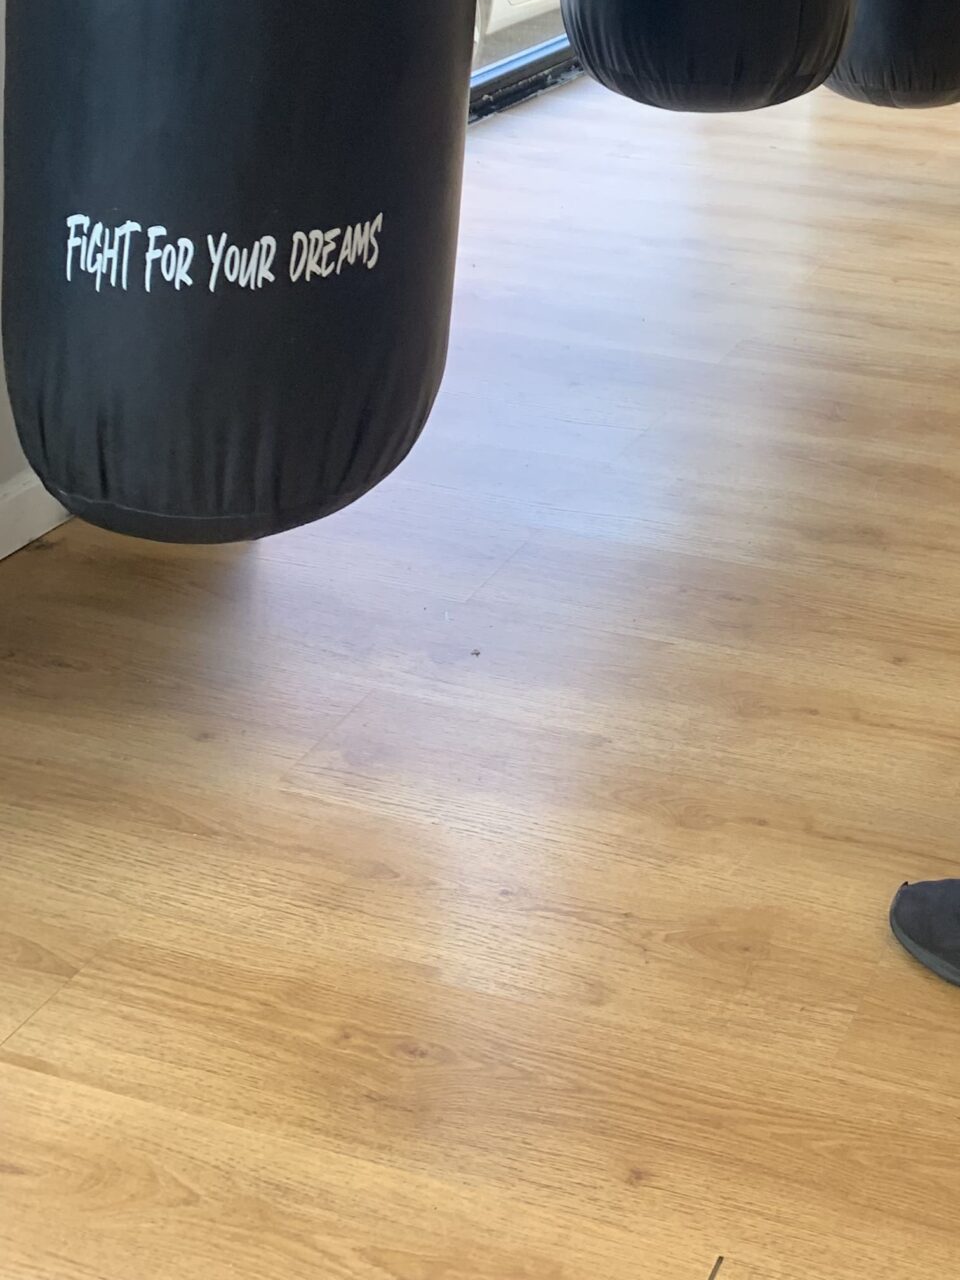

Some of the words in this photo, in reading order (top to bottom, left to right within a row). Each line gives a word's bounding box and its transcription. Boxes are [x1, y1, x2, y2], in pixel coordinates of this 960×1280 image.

[145, 226, 194, 292] FOR
[207, 232, 277, 291] YOUR
[289, 212, 382, 282] DREAMS
